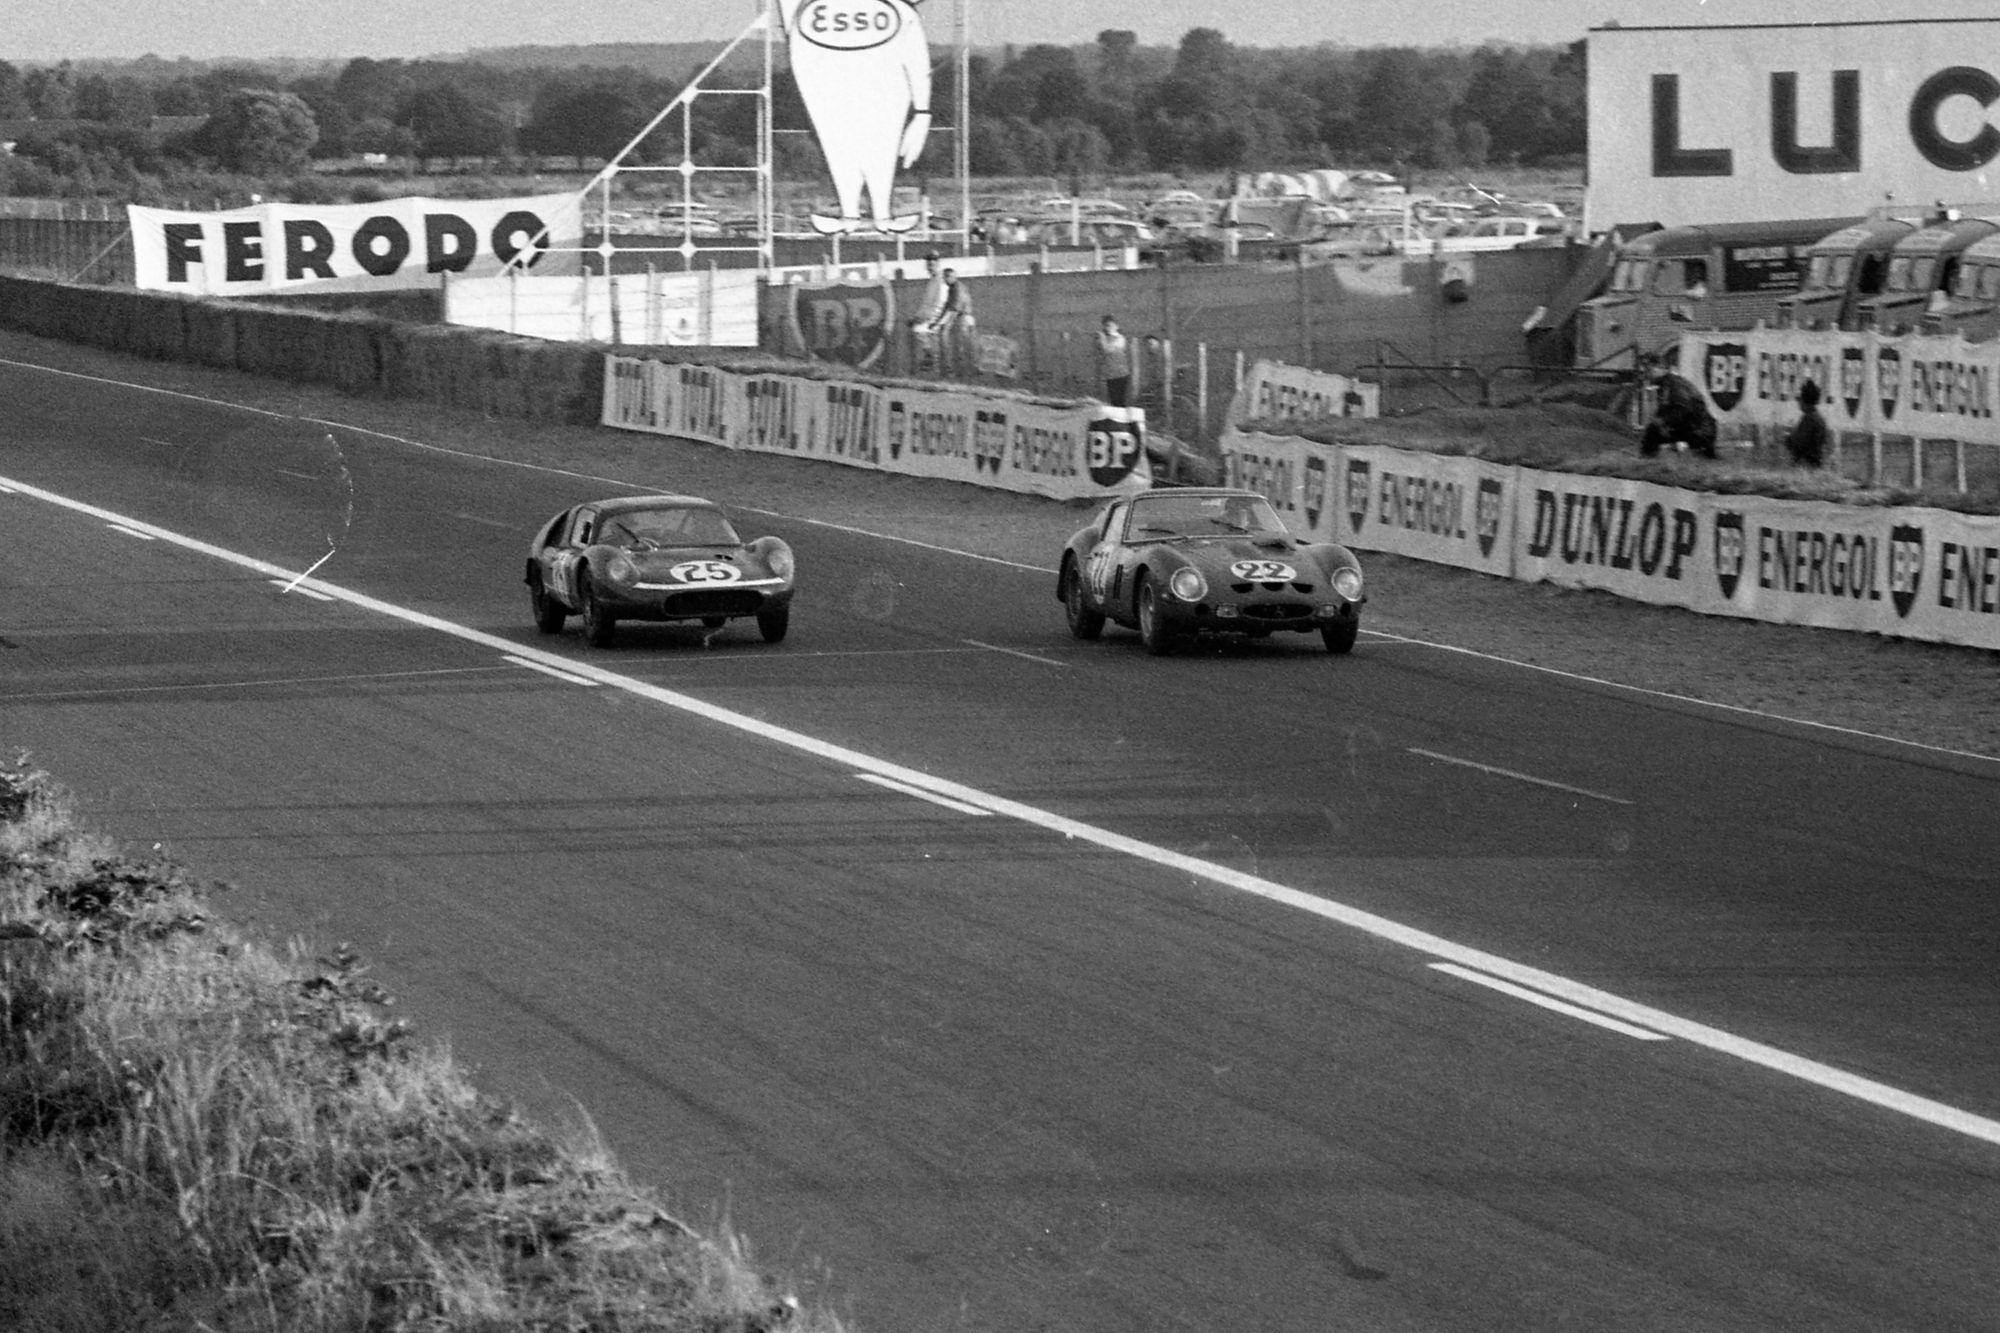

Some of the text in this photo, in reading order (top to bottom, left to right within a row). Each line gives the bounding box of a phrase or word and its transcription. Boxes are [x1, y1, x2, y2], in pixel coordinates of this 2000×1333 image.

[811, 5, 890, 32] Esso
[1652, 65, 2000, 178] LUC
[163, 210, 550, 283] FERODO
[811, 298, 882, 350] BP
[1088, 431, 1138, 469] BP
[1379, 471, 1467, 540] ENERGOL
[1529, 488, 1697, 581] DUNLOP
[680, 562, 732, 582] 25
[1235, 562, 1290, 579] 22
[1758, 526, 1882, 601] ENERGOL
